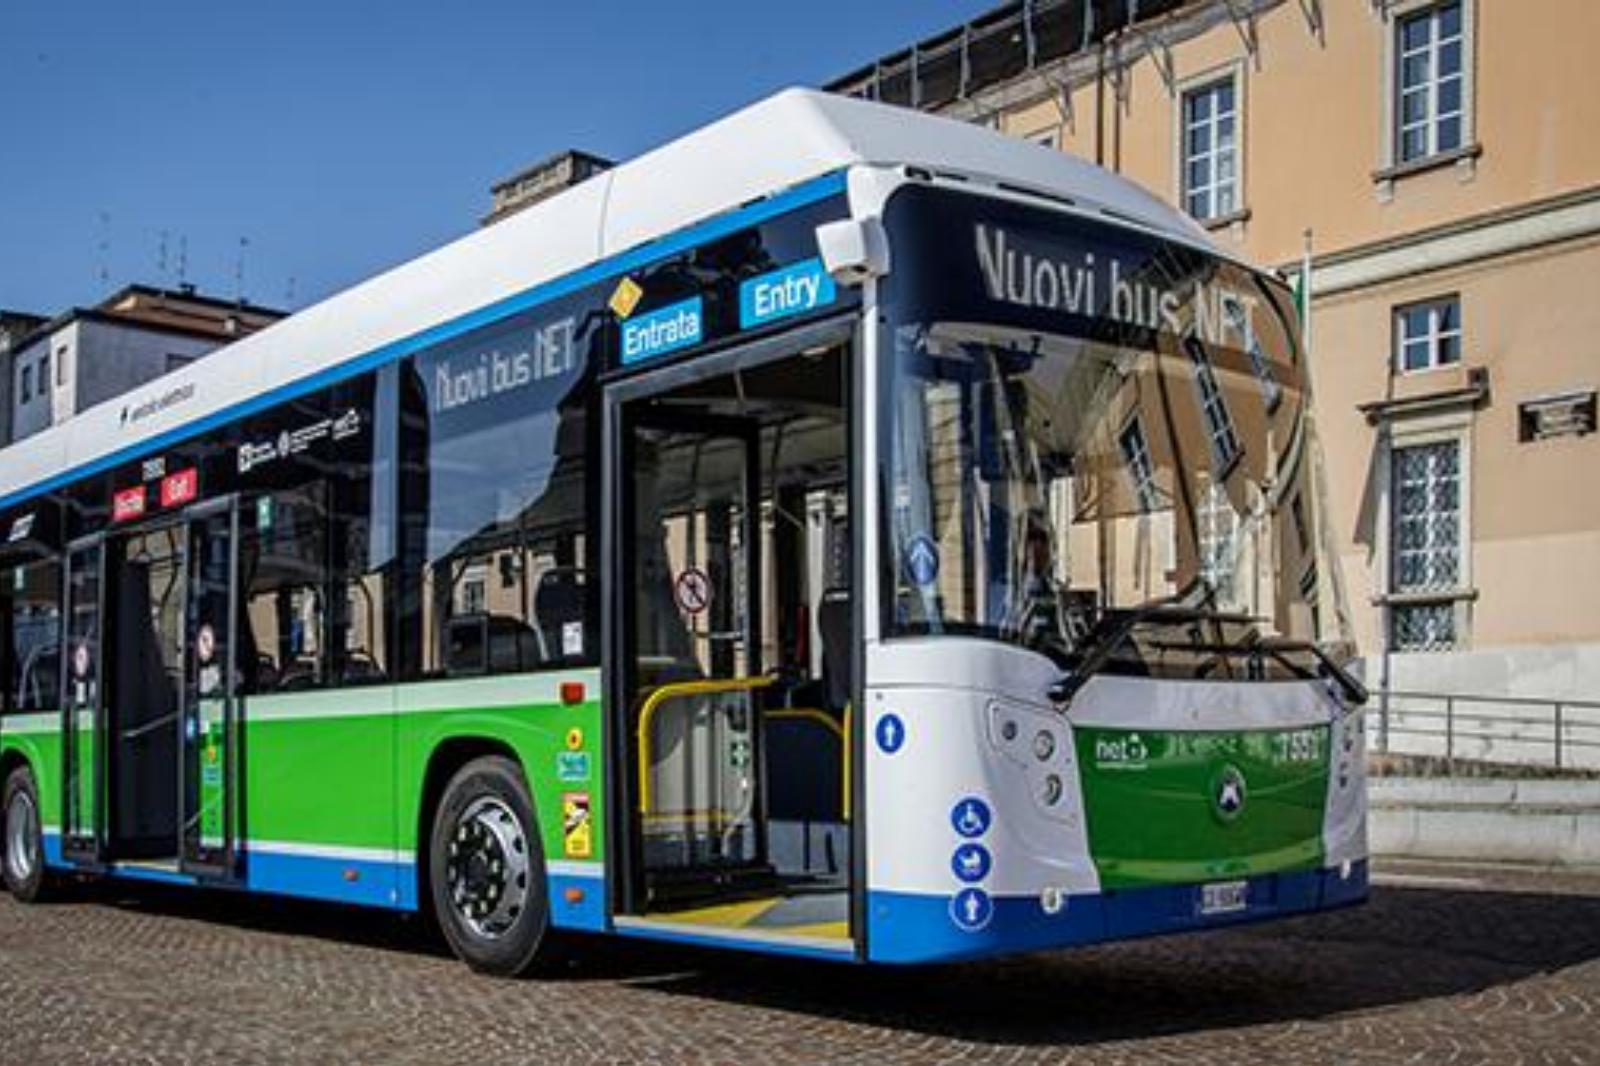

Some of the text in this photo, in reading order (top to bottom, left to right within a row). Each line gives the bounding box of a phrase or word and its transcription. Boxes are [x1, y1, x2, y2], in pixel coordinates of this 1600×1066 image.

[754, 272, 820, 317] Entry
[975, 223, 1095, 317] Nuovi
[1111, 258, 1181, 335] bus
[624, 309, 700, 355] Entrata
[493, 350, 531, 393] bus
